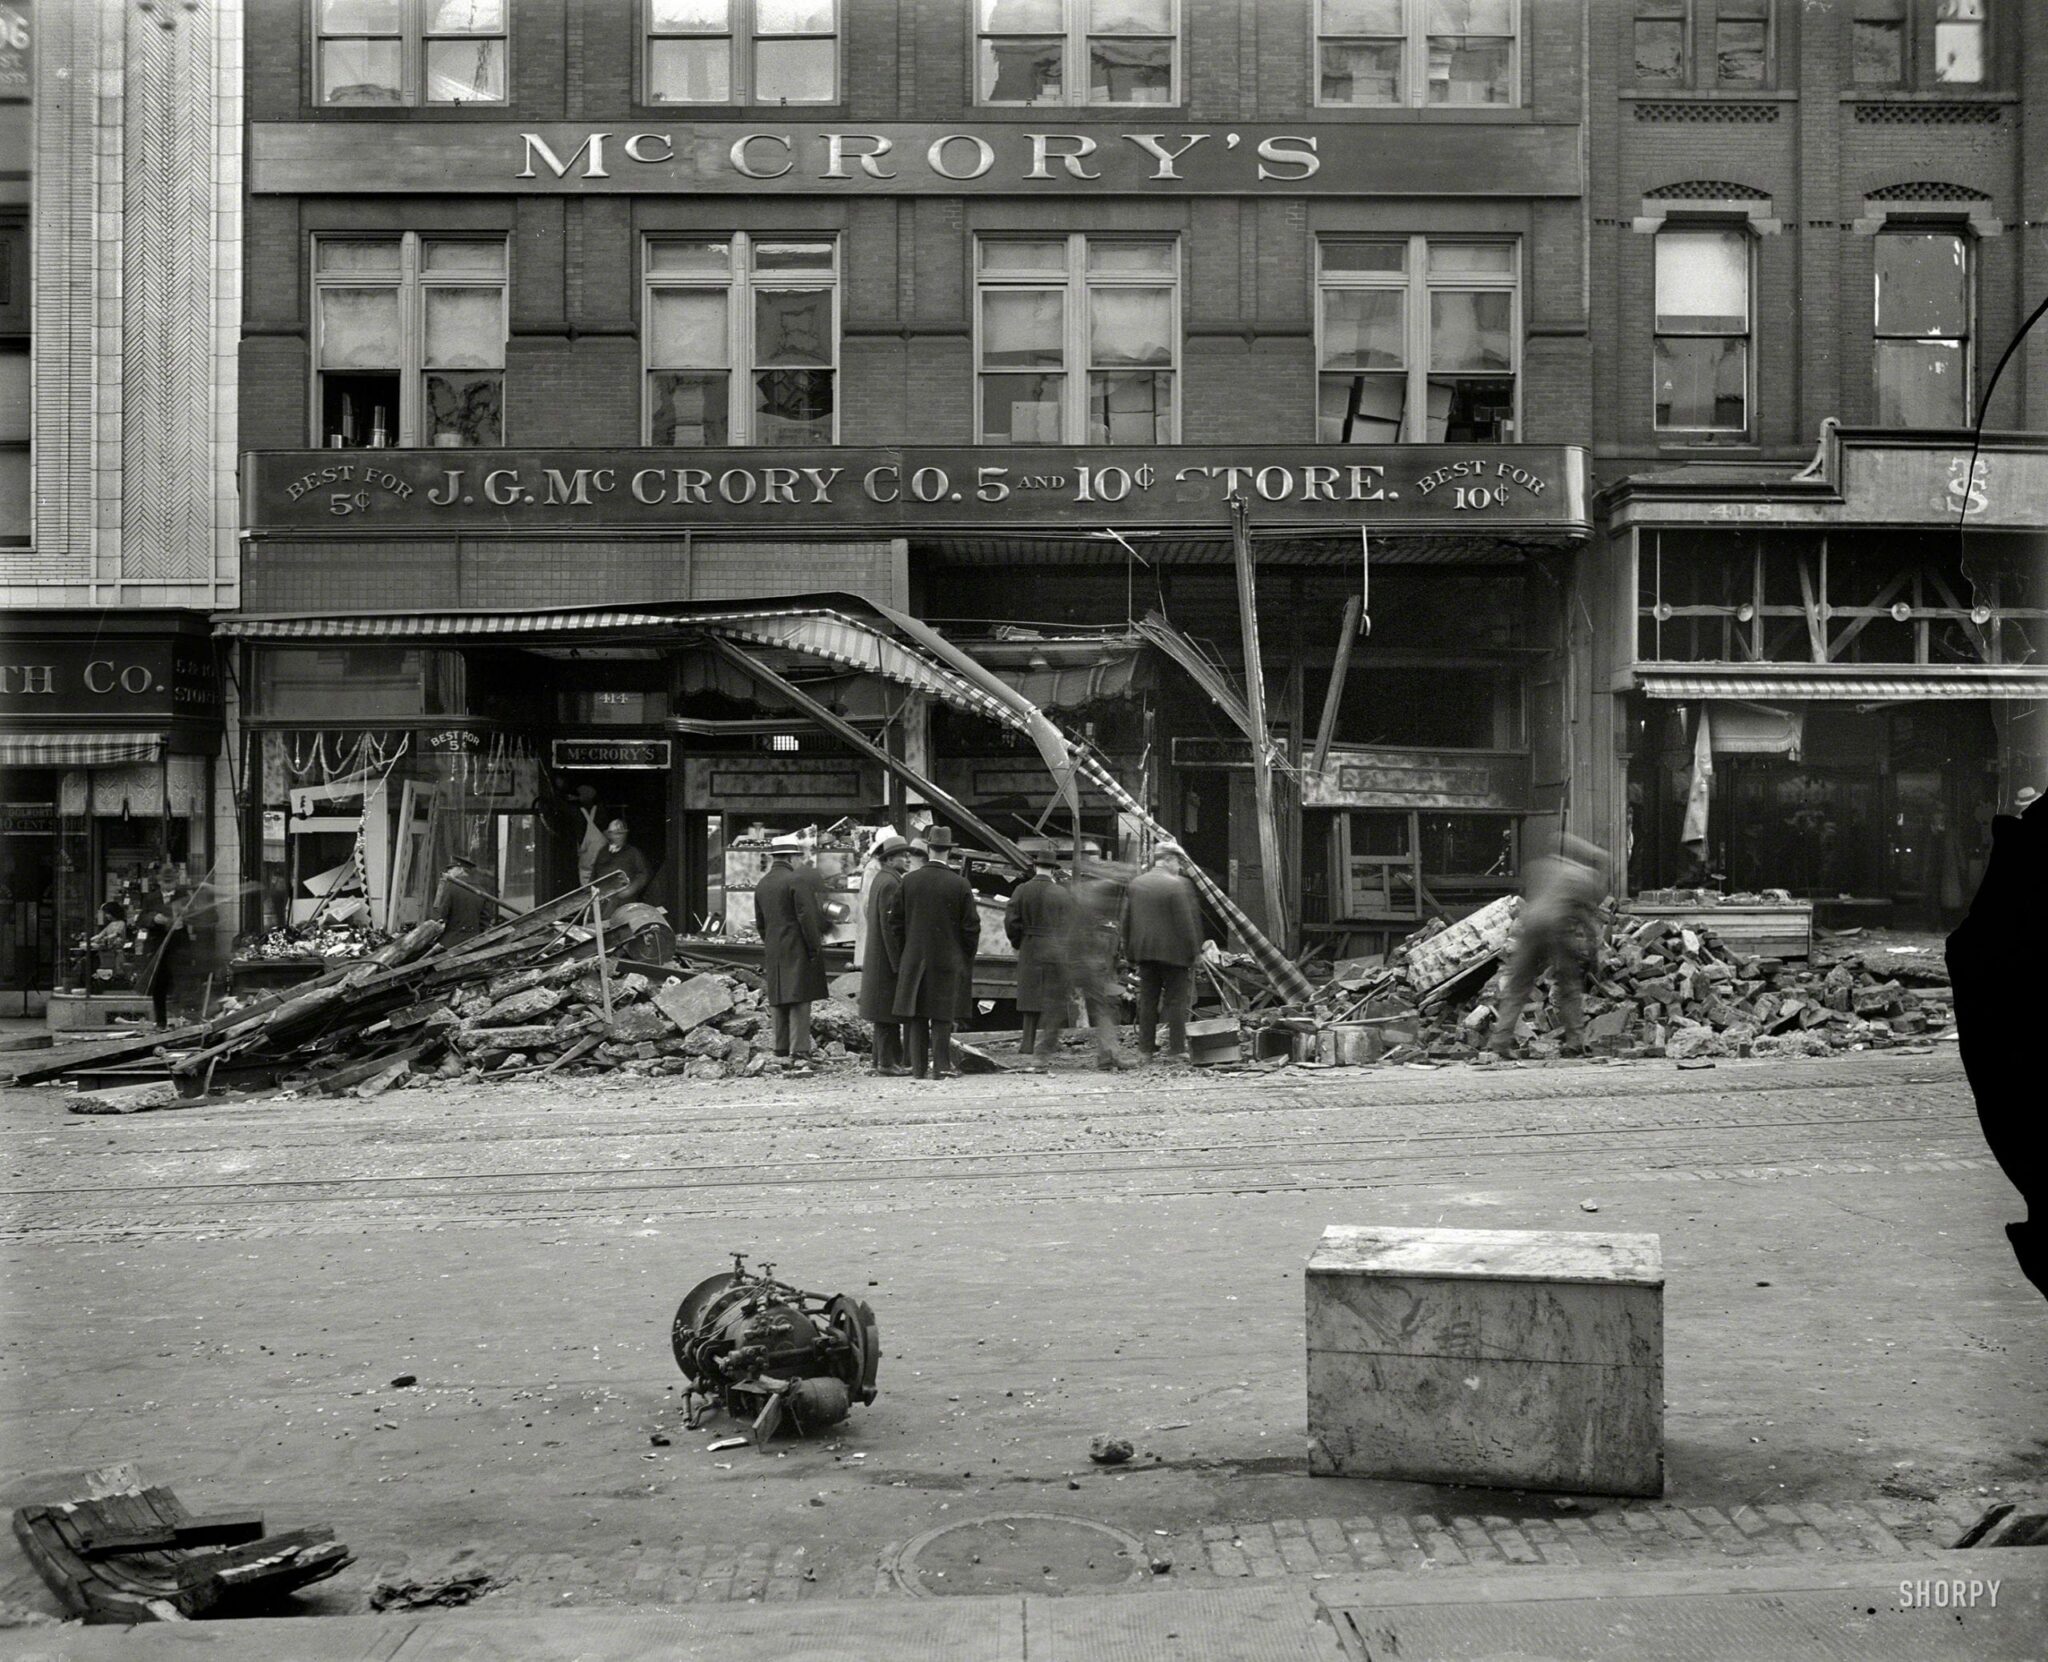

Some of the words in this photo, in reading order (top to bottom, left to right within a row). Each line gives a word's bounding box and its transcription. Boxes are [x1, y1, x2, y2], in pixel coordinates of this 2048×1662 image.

[285, 464, 355, 502] BEST
[363, 467, 415, 500] FOR
[863, 466, 962, 502] CO.
[976, 466, 1010, 502] 5
[1017, 475, 1066, 489] AND
[1072, 464, 1156, 502] 10¢
[1416, 460, 1486, 495] BEST
[1496, 462, 1546, 496] FOR
[329, 488, 371, 516] 5¢
[1453, 483, 1510, 510] 10¢
[1709, 504, 1772, 519] 418
[0, 665, 56, 694] TH
[598, 692, 629, 704] 414
[430, 730, 459, 747] BEST
[461, 730, 480, 747] FOR
